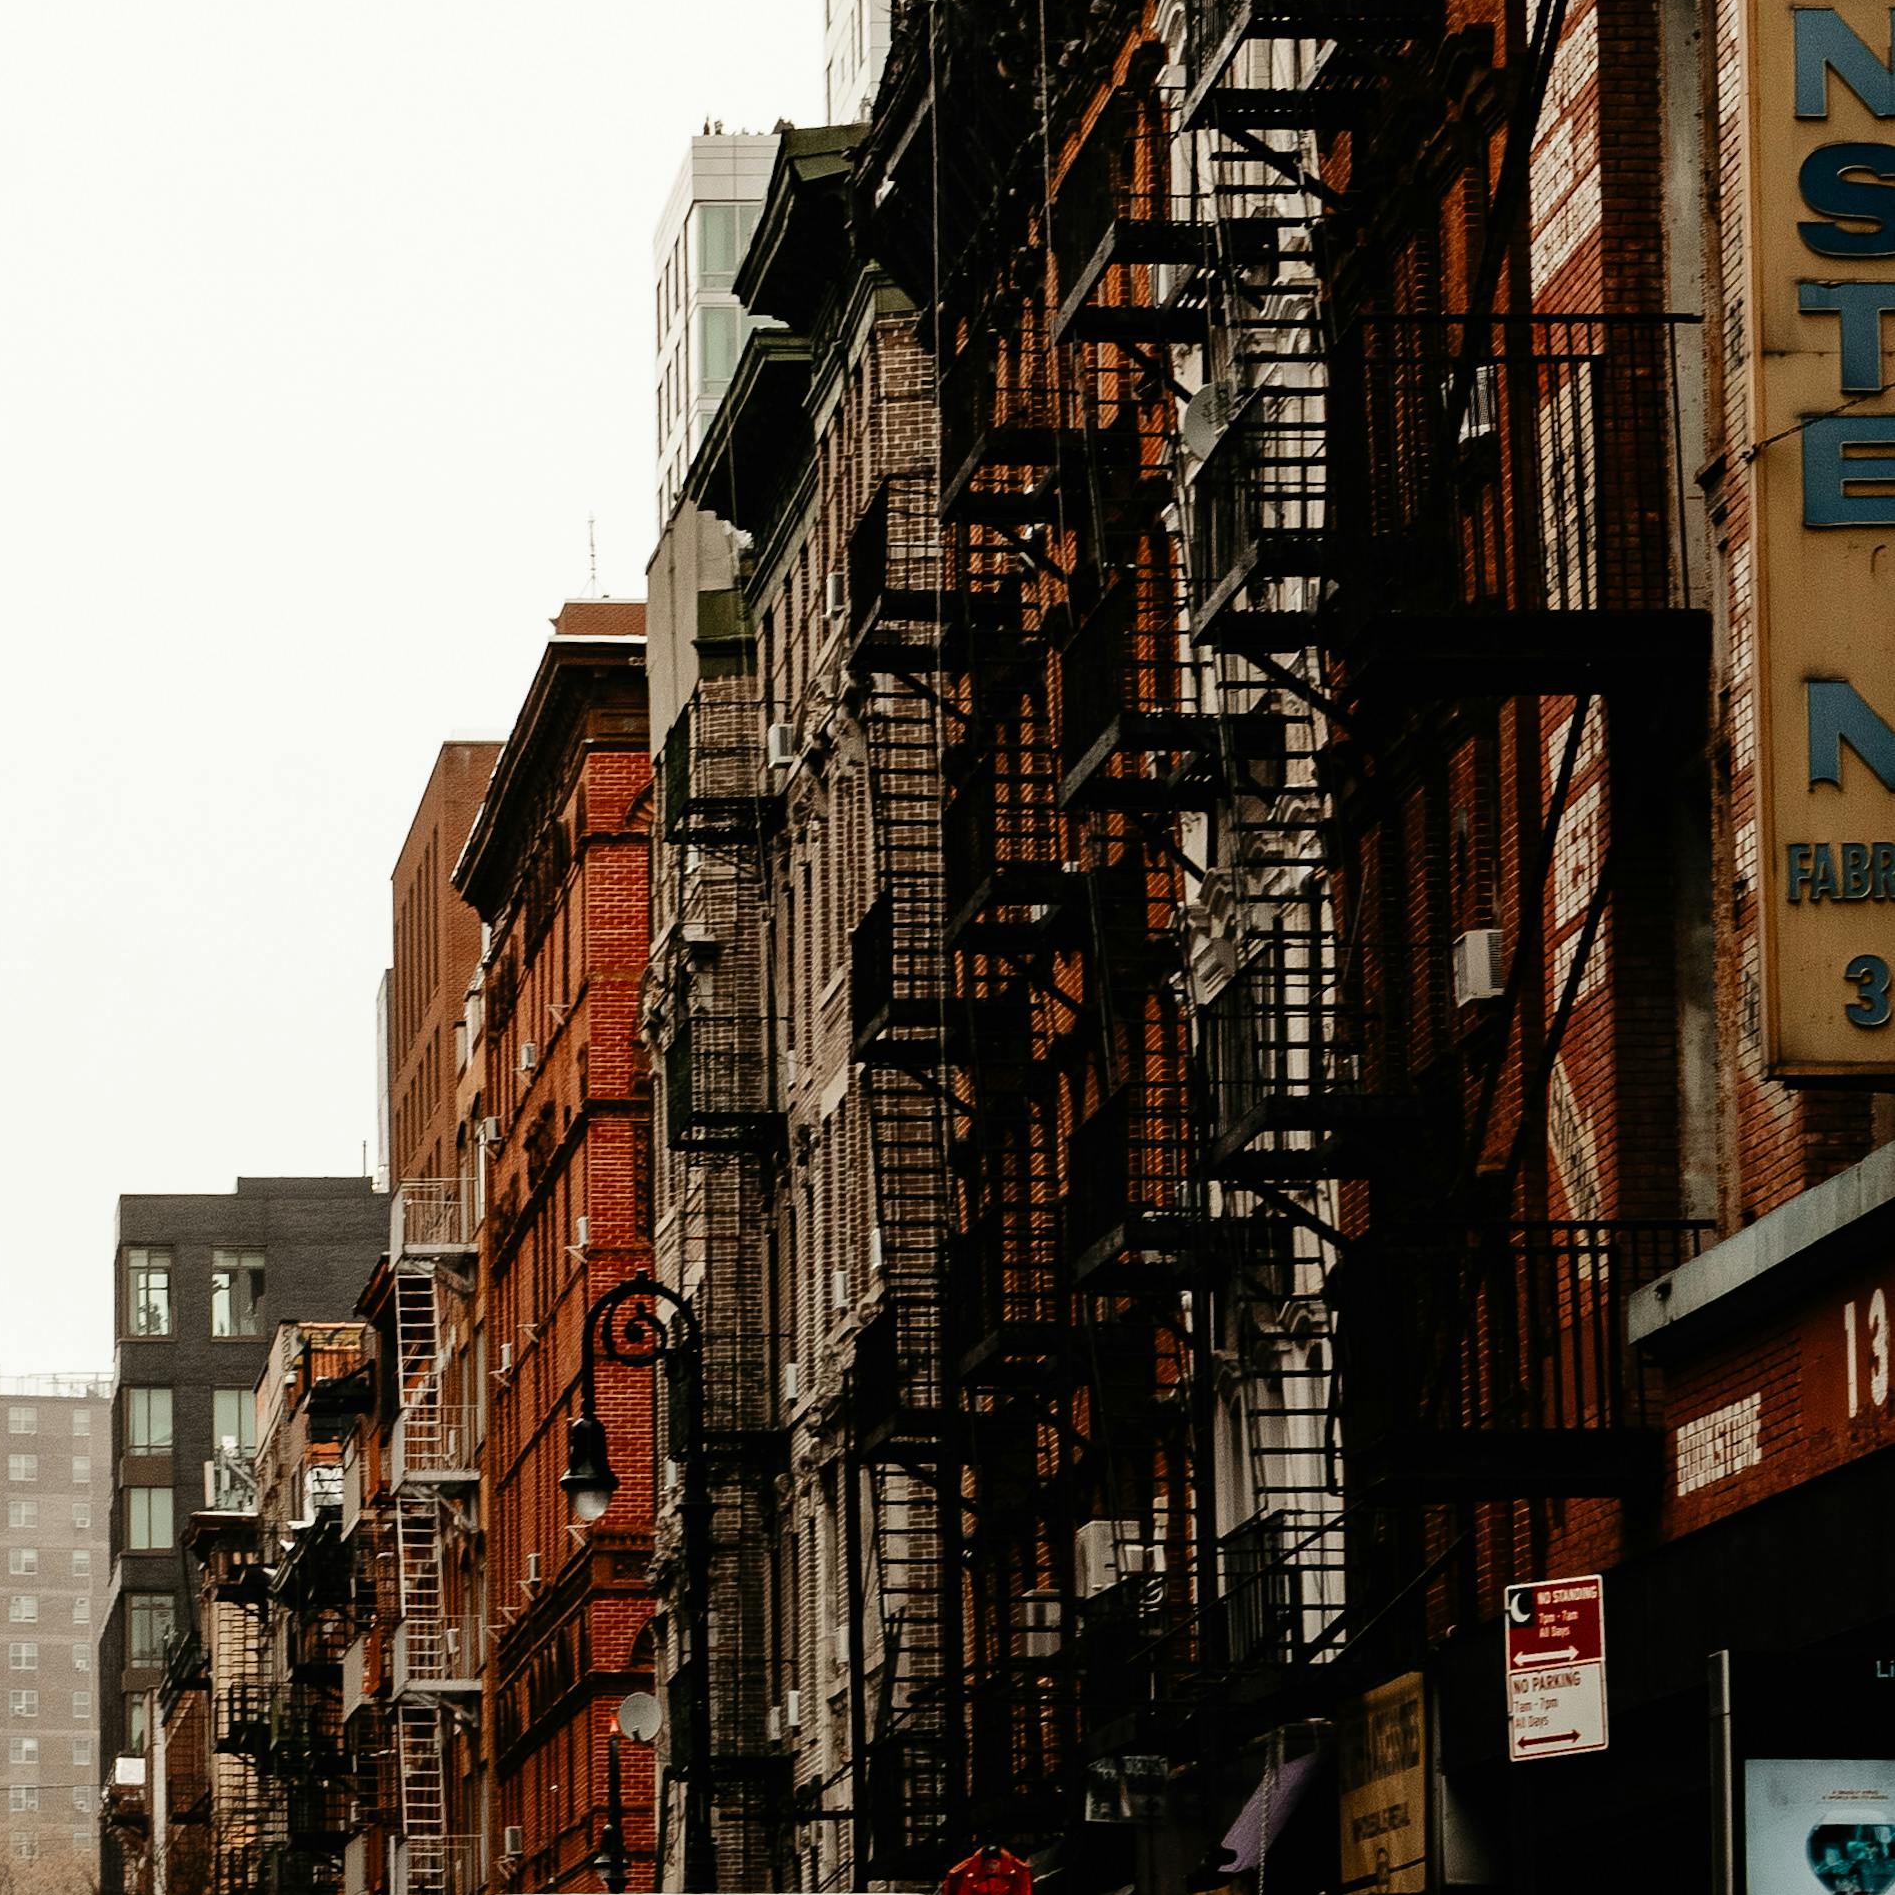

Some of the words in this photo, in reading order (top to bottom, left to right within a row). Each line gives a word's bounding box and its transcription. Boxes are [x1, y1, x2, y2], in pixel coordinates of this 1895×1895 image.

[1844, 954, 1892, 1026] 3
[1845, 1289, 1890, 1419] 13
[1552, 1585, 1598, 1604] STANDING
[1513, 1678, 1529, 1694] NO
[1532, 1671, 1582, 1693] PARKING
